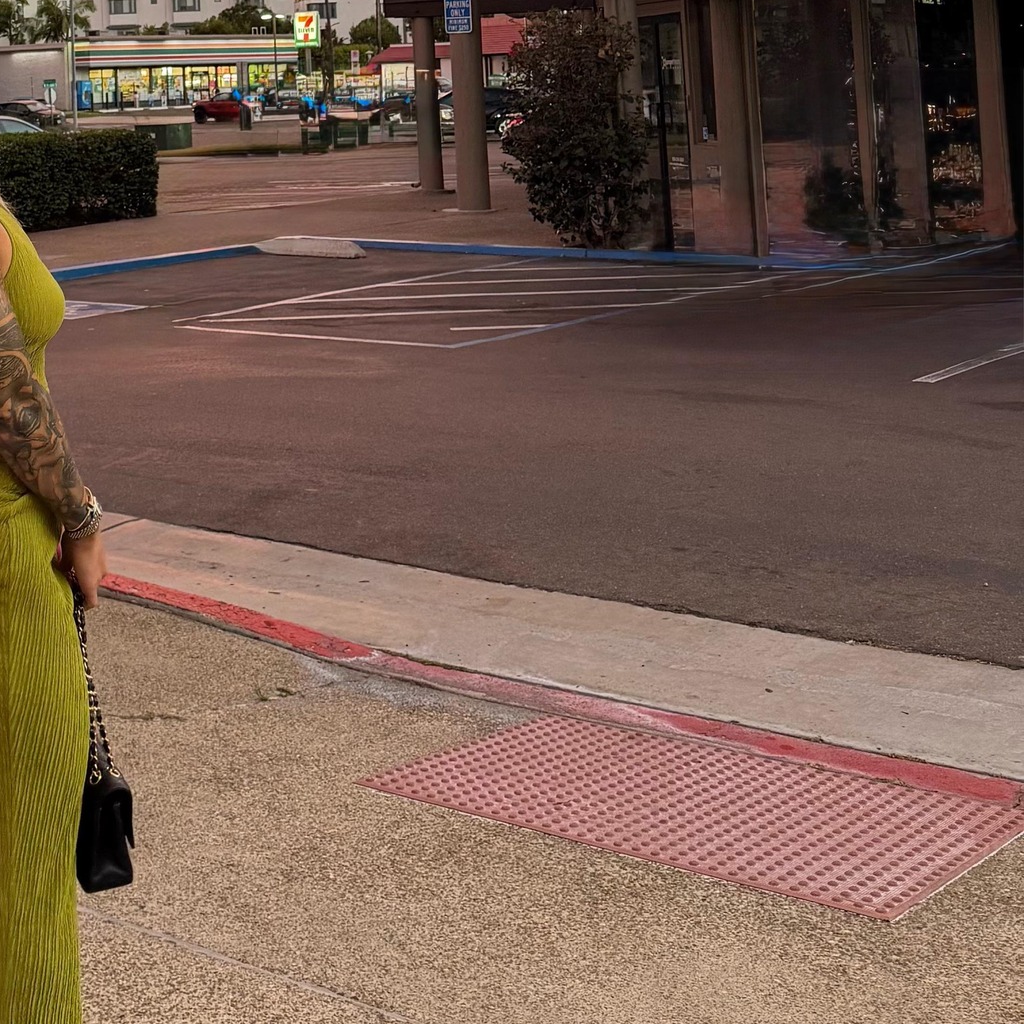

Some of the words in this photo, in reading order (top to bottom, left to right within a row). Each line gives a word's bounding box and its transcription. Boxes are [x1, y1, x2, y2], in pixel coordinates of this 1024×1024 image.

[446, 0, 469, 9] PARKING
[450, 9, 465, 17] ONLY
[298, 16, 313, 42] 7
